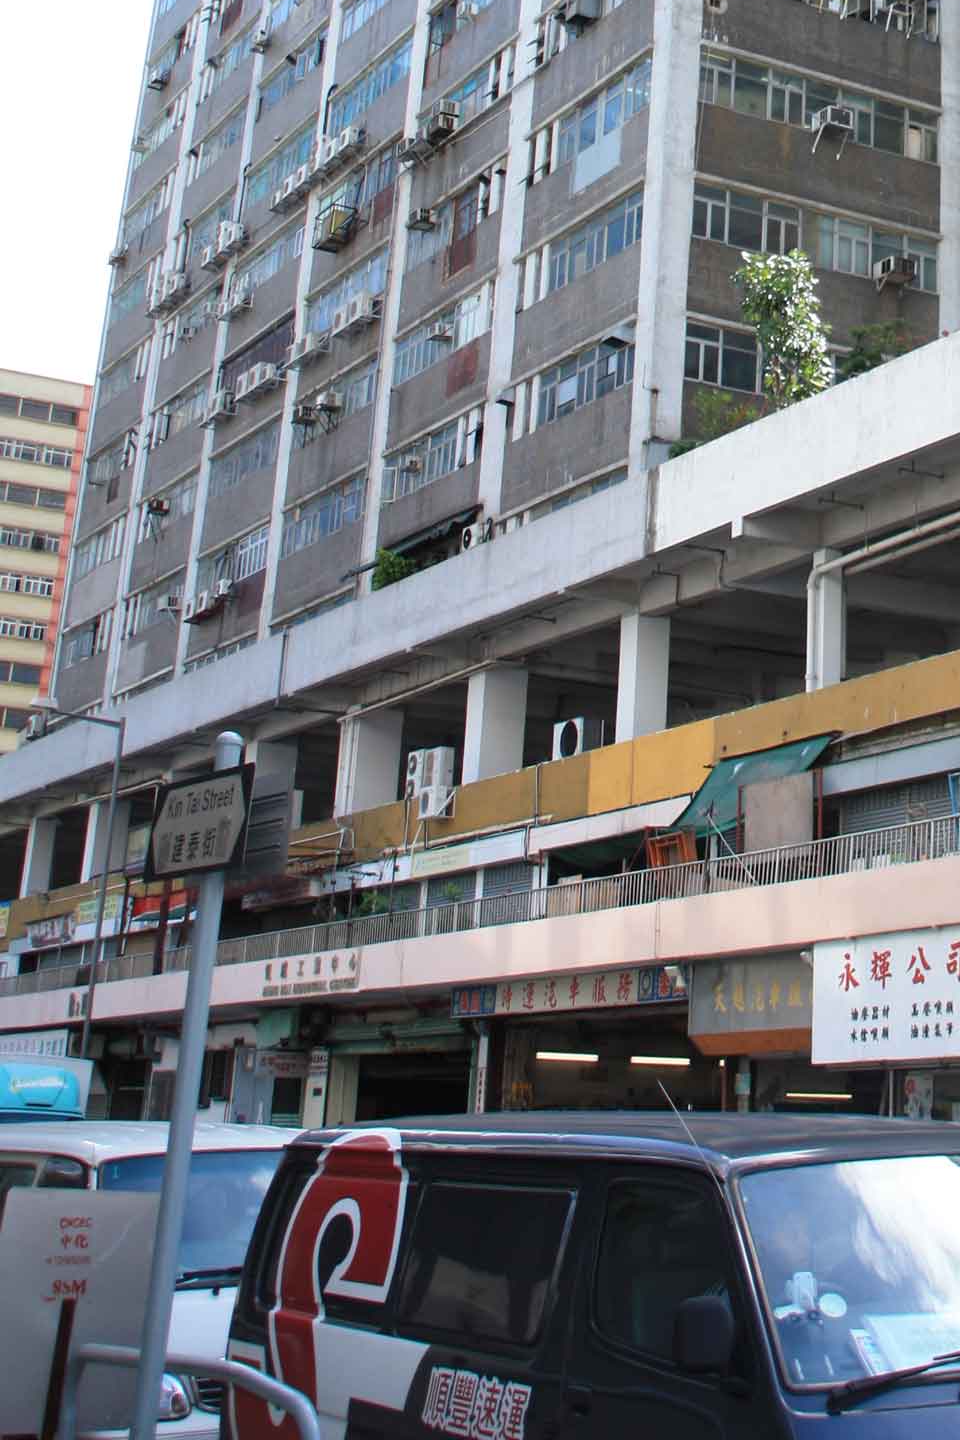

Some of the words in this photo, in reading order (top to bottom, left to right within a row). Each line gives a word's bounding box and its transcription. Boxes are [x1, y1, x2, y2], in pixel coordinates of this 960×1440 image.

[167, 795, 184, 818] Kin
[202, 783, 235, 811] Street
[420, 1364, 533, 1440] 順豐速運
